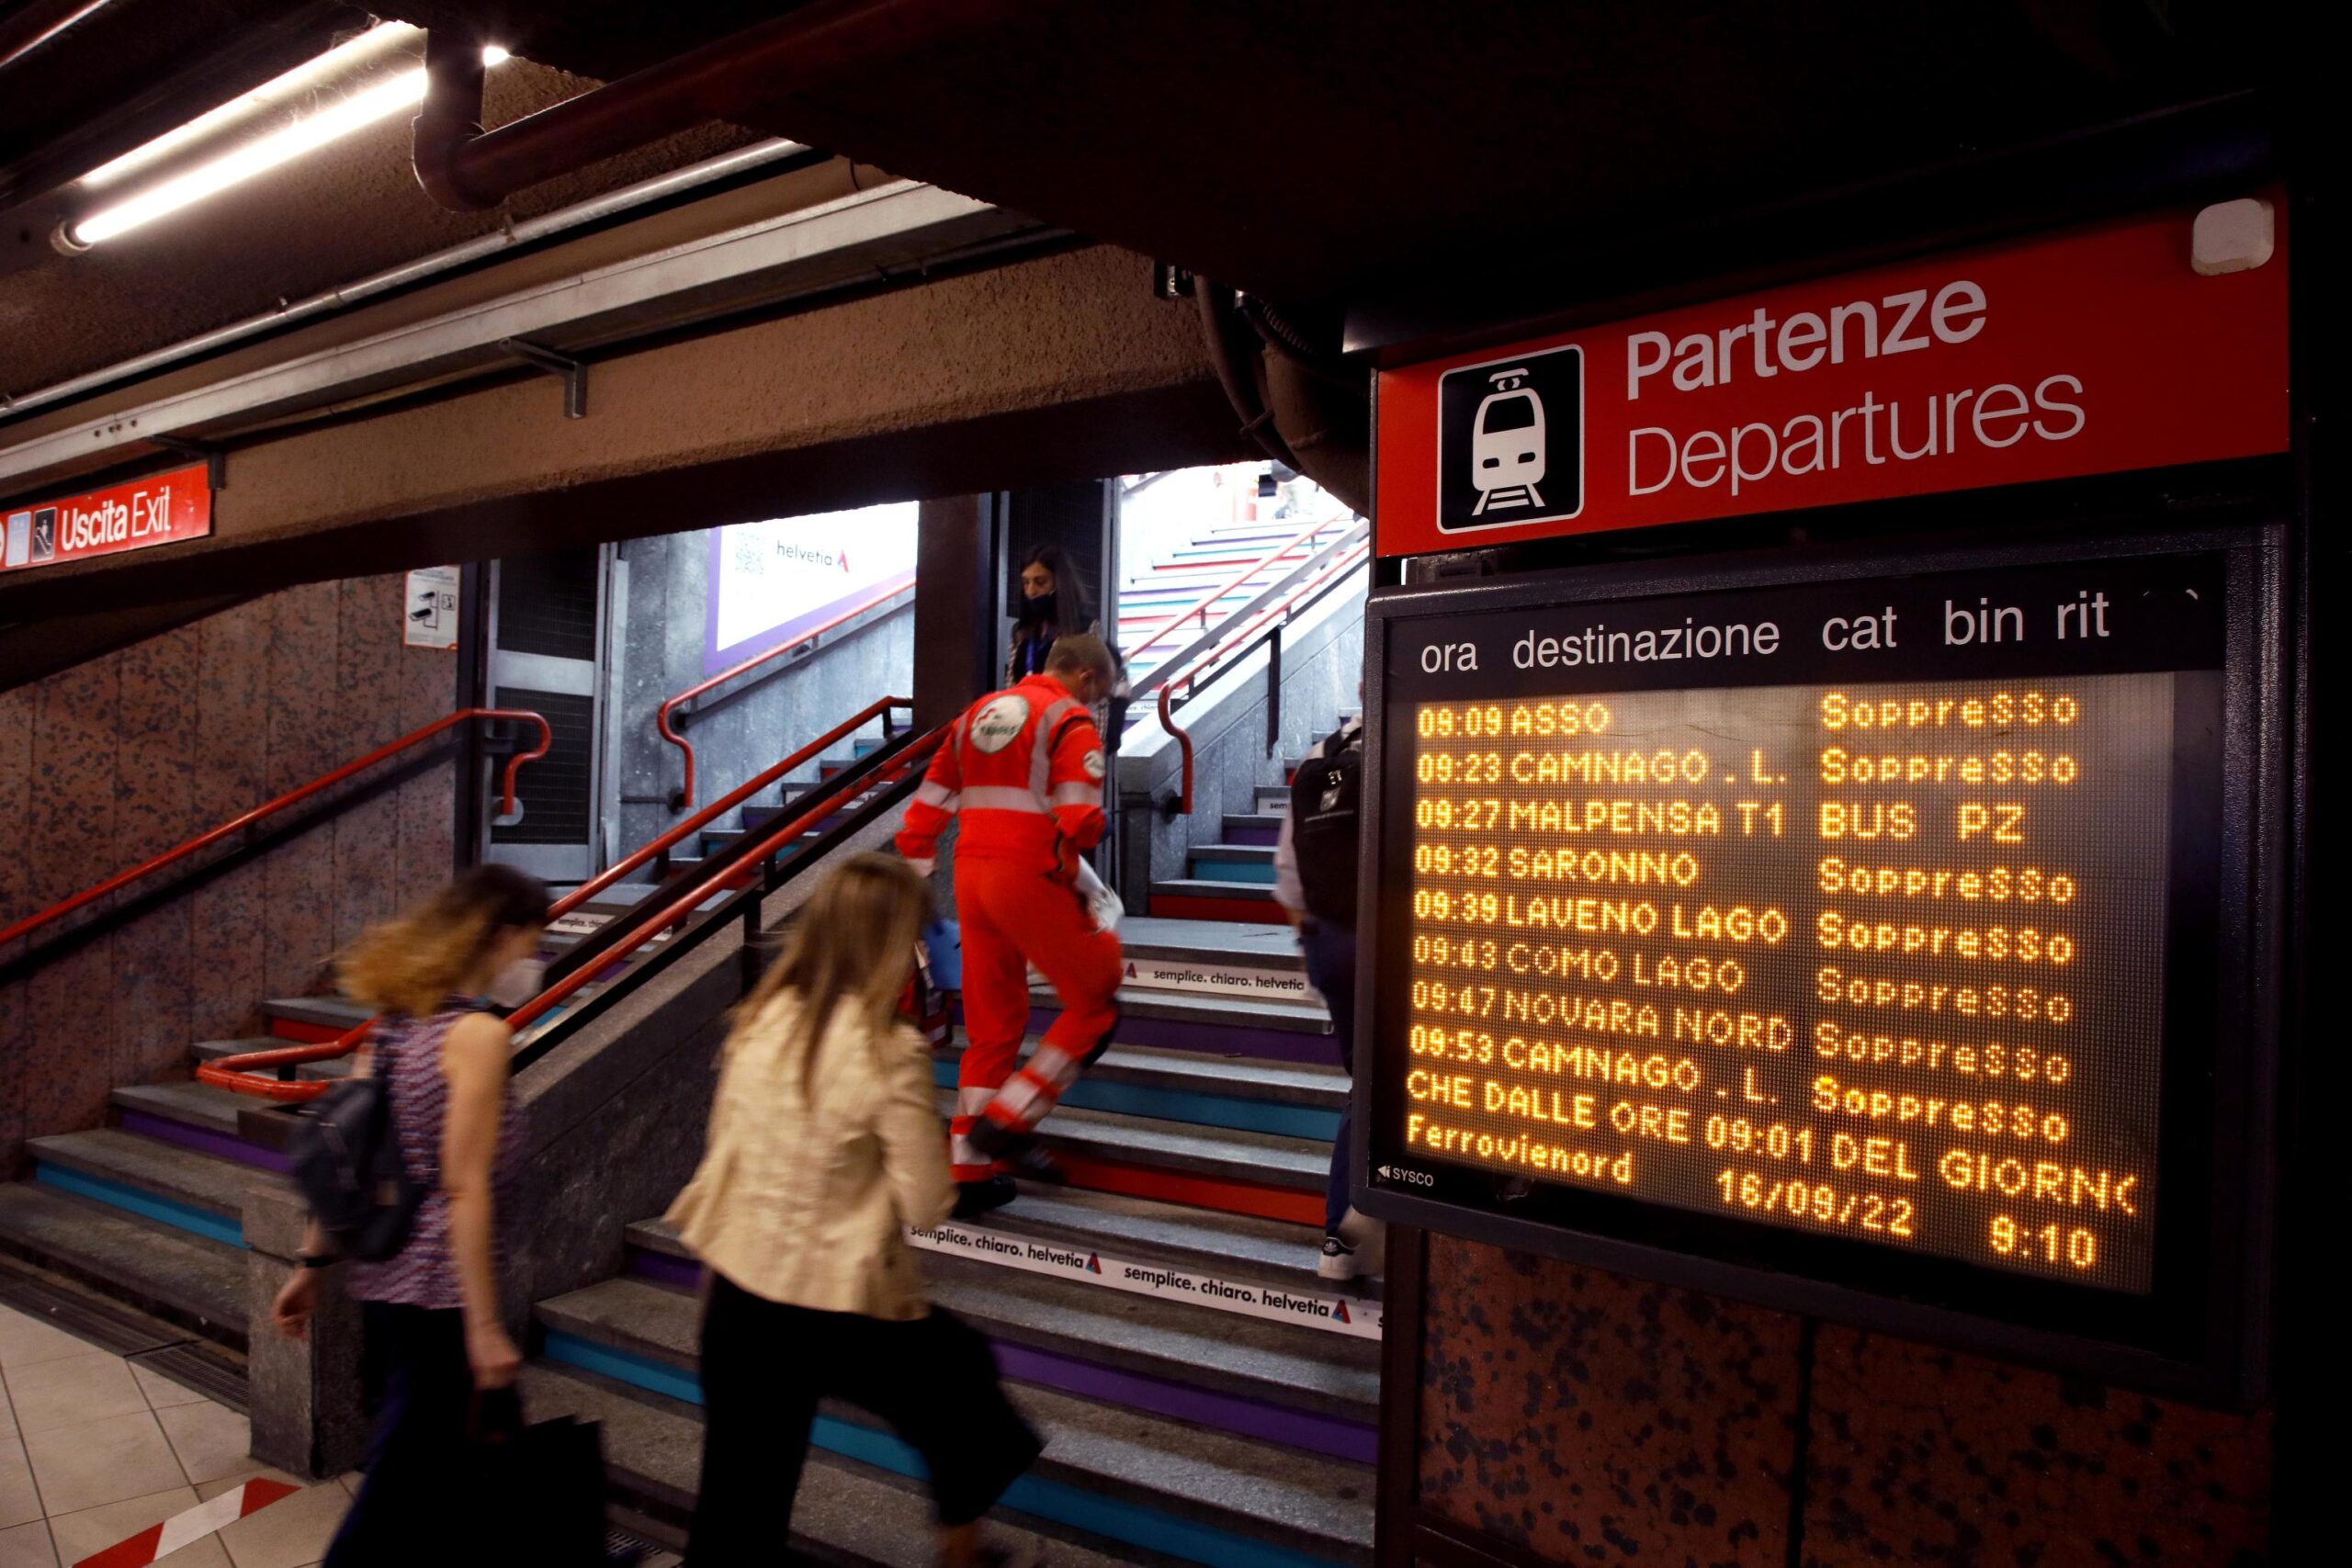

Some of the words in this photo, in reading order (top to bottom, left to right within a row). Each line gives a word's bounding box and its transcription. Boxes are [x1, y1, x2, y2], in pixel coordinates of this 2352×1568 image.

[1627, 279, 1987, 401] Partenze
[1628, 374, 2086, 496] Departures
[62, 500, 128, 551] Uscita
[131, 485, 172, 538] Exit
[776, 540, 832, 567] helvetia
[1420, 640, 1478, 673] ora
[1512, 617, 1780, 669] destinazione
[1823, 606, 1897, 650] cat
[1944, 597, 2024, 645] bin
[2057, 591, 2110, 639] rit
[1418, 706, 1501, 737] 09:09
[1510, 703, 1611, 736] ASSO
[1820, 693, 2078, 728] Soppresso
[1416, 752, 1501, 783] 09:23
[1510, 750, 1709, 784] CAMNAGO
[1820, 749, 2078, 784] Soppresso
[1416, 799, 1500, 829] 09:27
[1510, 801, 1721, 835] MALPENSA
[1736, 802, 1783, 837] T1
[1819, 804, 1917, 839] BUS
[1960, 804, 2025, 842] PZ
[1415, 845, 1498, 877] 09:32
[1509, 848, 1699, 886] SARONNO
[1819, 858, 2075, 902] Soppresso
[1413, 891, 1498, 923] 09:39
[1506, 895, 1658, 934] LAVENO
[1672, 905, 1787, 942] LAGO
[1818, 915, 2075, 964] Soppresso
[1154, 969, 1207, 984] semplice.
[1210, 972, 1251, 987] chiaro.
[1256, 976, 1305, 990] helvetia
[1413, 936, 1497, 970] 09:43
[1507, 944, 1619, 981] COMO
[1634, 953, 1745, 992] LAGO
[1816, 968, 2073, 1023] Soppresso
[1412, 981, 1495, 1016] 09:47
[1506, 991, 1658, 1036] NOVARA
[1675, 1010, 1793, 1052] NORD
[1815, 1021, 2072, 1084] Soppresso
[1409, 1026, 1494, 1063] 09:53
[1504, 1039, 1699, 1091] CAMNAGO
[1813, 1077, 2069, 1143] Soppresso
[1407, 1071, 1472, 1106] CHE
[1485, 1082, 1597, 1128] DALLE
[1611, 1102, 1690, 1142] ORE
[1706, 1116, 1811, 1163] 09:01
[1831, 1134, 1918, 1180] DEL
[1393, 1168, 1433, 1187] SYSCO
[1407, 1114, 1632, 1184] Ferrovienord
[1717, 1169, 1913, 1236] 16/09/22
[1989, 1216, 2096, 1268] 9:10
[975, 1235, 1023, 1258] chiaro.
[1027, 1245, 1084, 1269] helvetia
[1124, 1266, 1196, 1291] semplice.
[1201, 1279, 1257, 1303] chiaro.
[1262, 1291, 1329, 1317] helvetia
